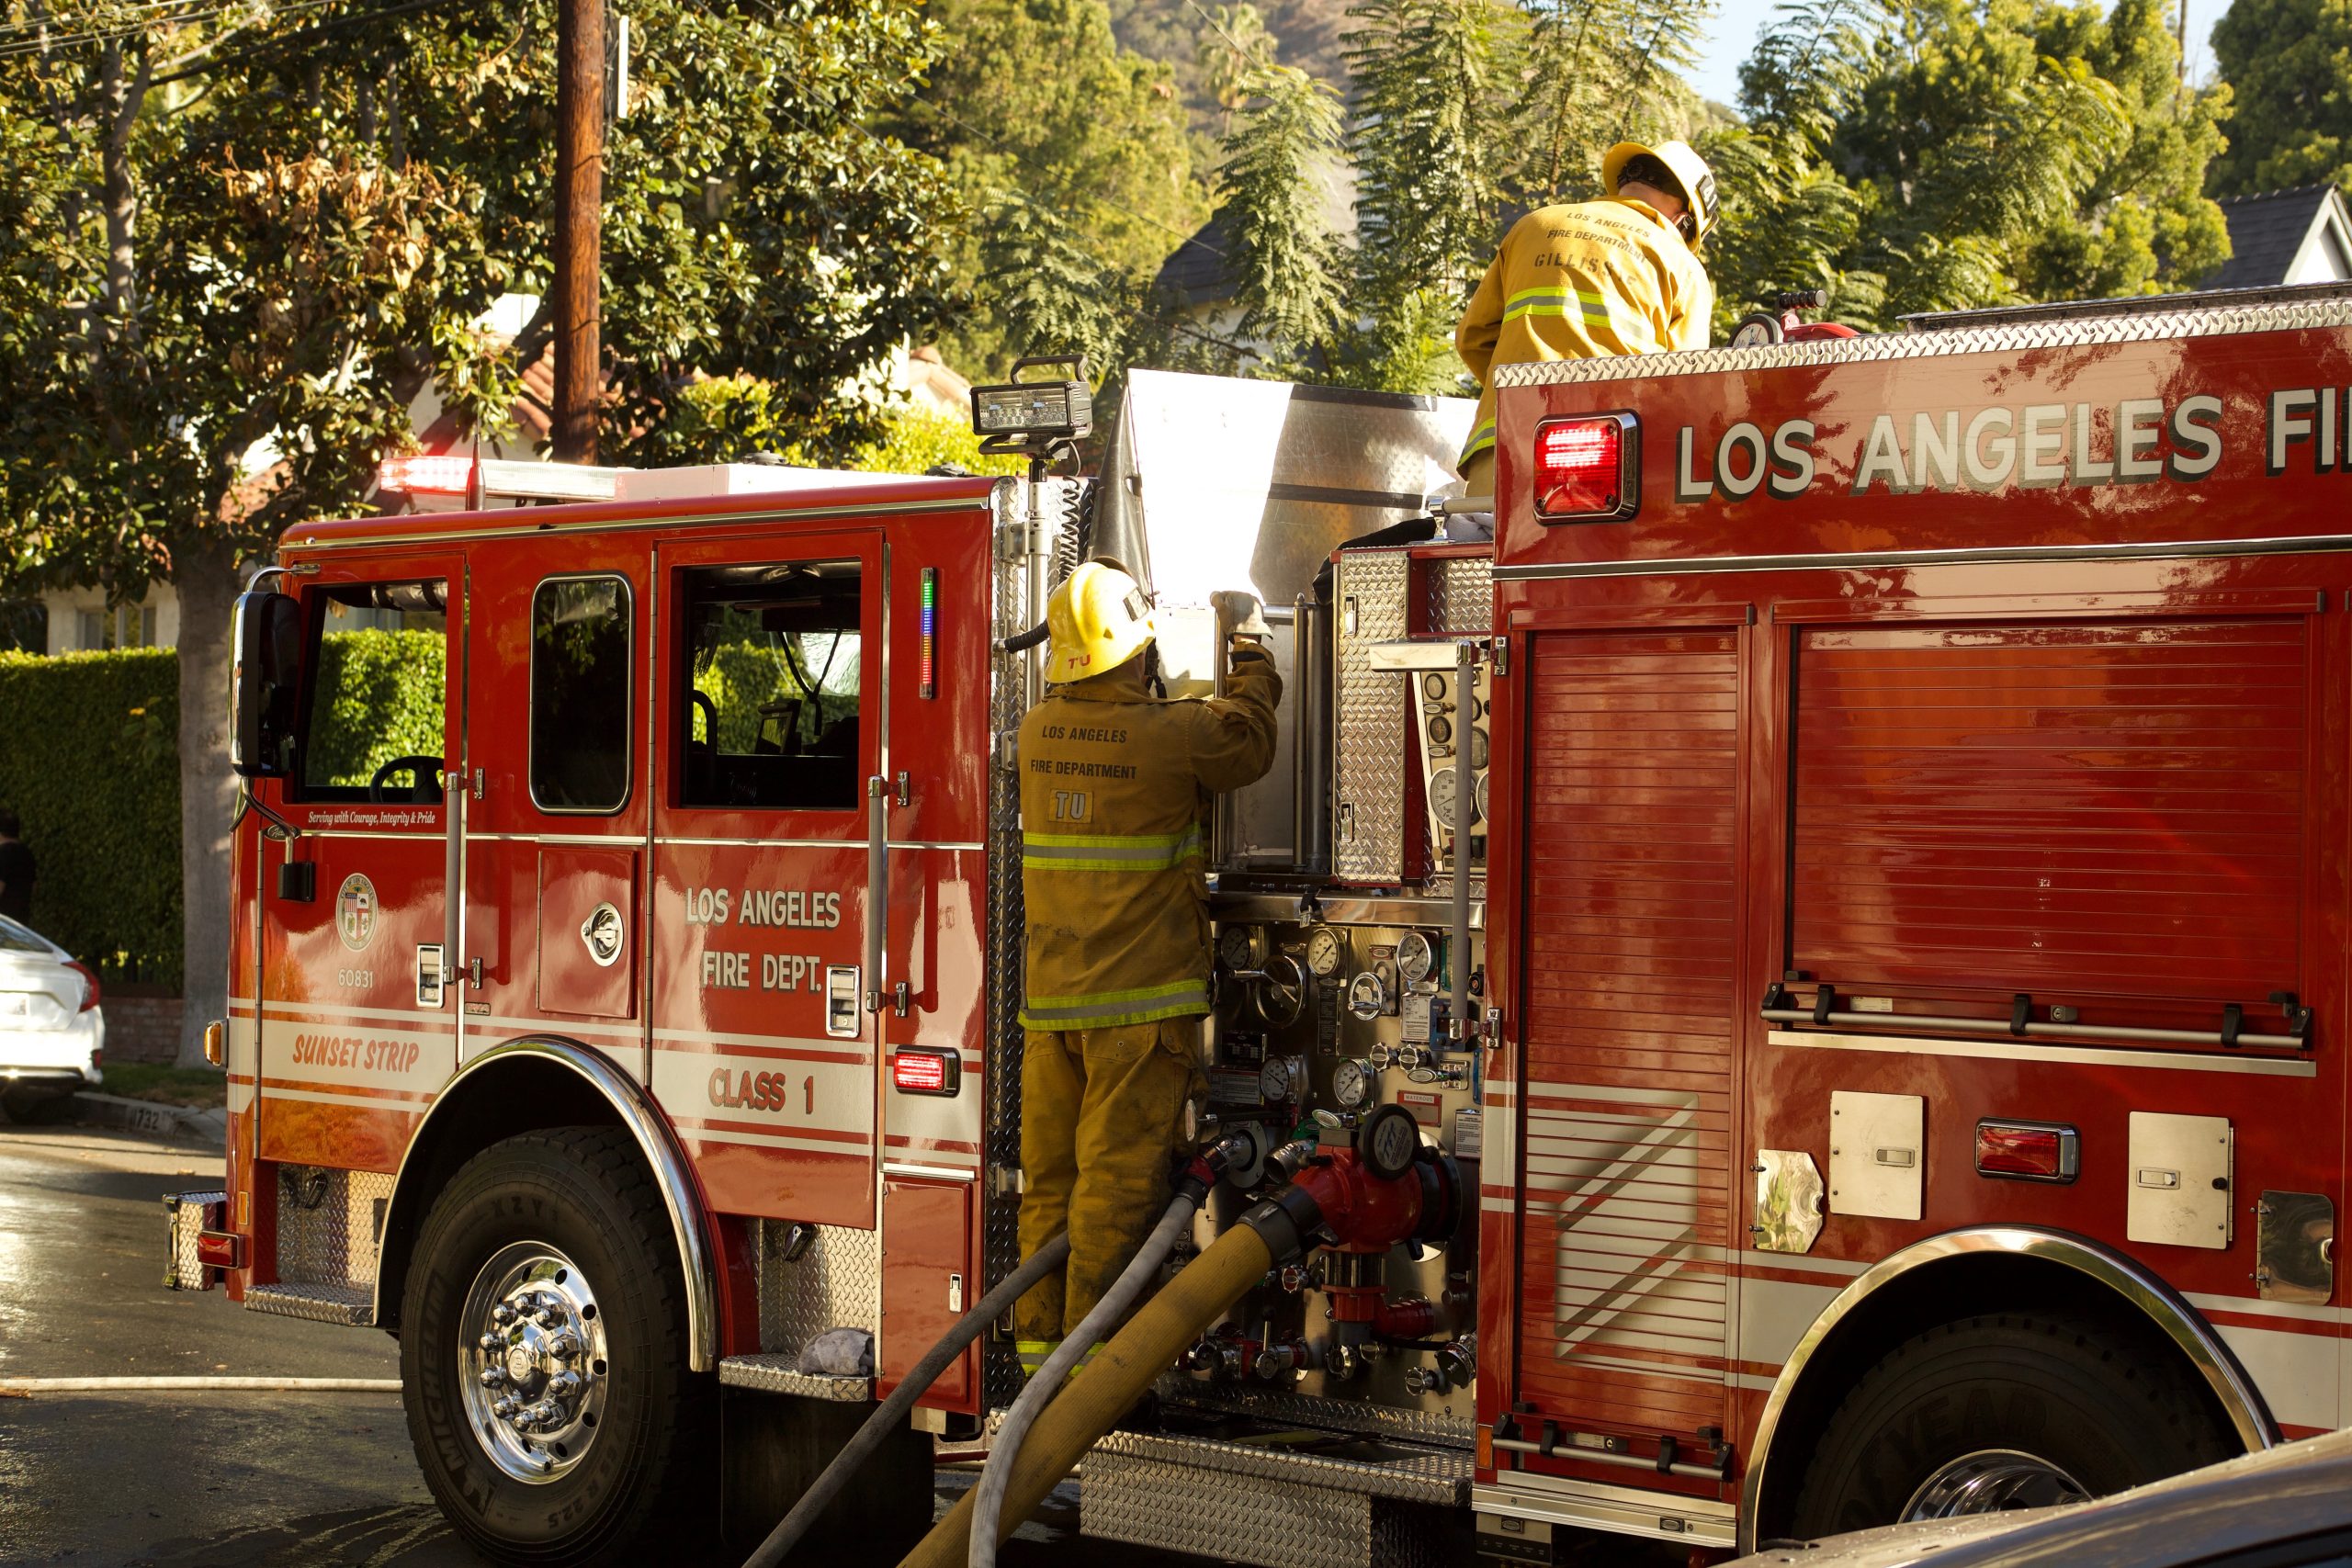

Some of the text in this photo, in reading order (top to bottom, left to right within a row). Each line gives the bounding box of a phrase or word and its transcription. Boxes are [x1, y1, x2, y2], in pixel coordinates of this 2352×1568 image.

[1566, 212, 1651, 238] LOS ANGELES
[1546, 229, 1646, 264] FIRE DEPARTMENT
[1675, 386, 2352, 503] LOS ANGELES FI
[1068, 654, 1091, 670] TU
[1042, 725, 1128, 743] LOS ANGELES
[1030, 759, 1137, 780] FIRE DEPARTMENT
[308, 810, 435, 827] Serving with Courage, Integrity & Pride
[1055, 791, 1086, 820] TU
[686, 886, 841, 930] LOS ANGELES
[338, 968, 374, 988] 60831
[701, 950, 822, 993] FIRE DEPT.
[292, 1033, 420, 1074] SUNSET STRIP
[707, 1066, 815, 1114] CLASS 1
[421, 1274, 467, 1472] MICHELIN
